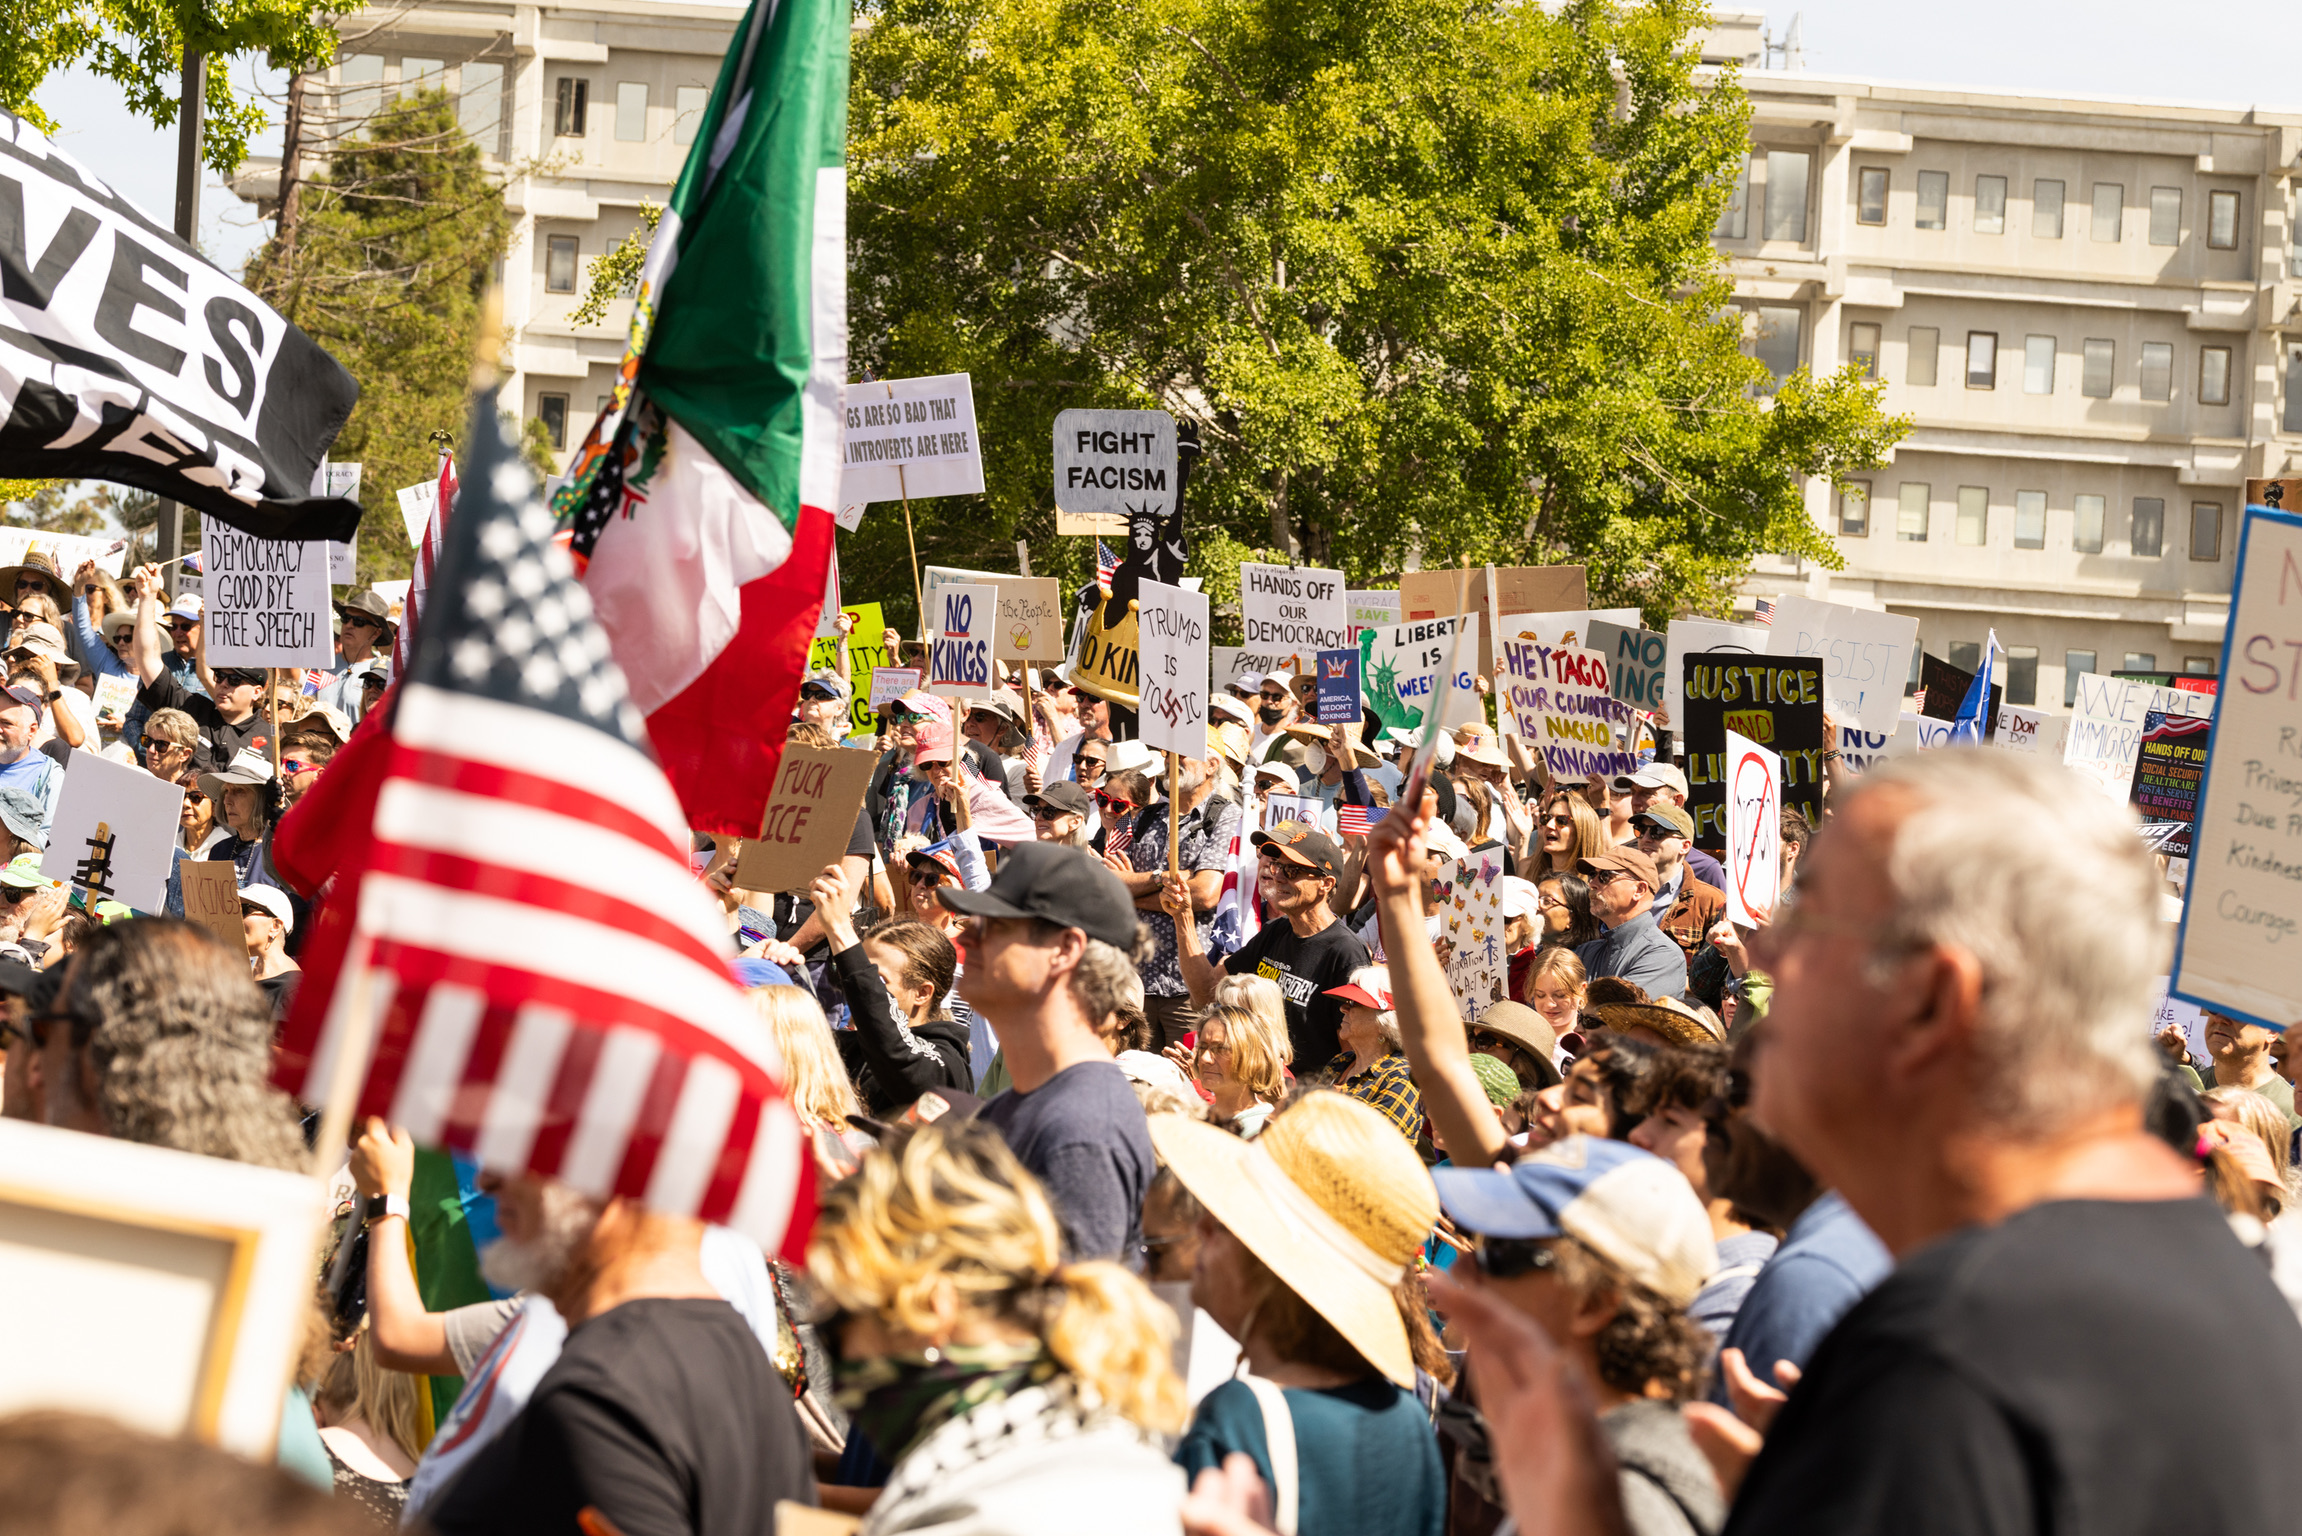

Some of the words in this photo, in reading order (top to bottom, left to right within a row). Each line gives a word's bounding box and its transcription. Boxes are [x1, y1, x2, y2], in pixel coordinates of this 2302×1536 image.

[865, 405, 885, 427] ARE
[887, 403, 901, 425] SO
[904, 401, 926, 424] BAD
[929, 398, 956, 421] THAT
[851, 436, 913, 464] INTROVERTS
[917, 435, 939, 457] ARE
[940, 432, 969, 455] HERE
[1077, 431, 1155, 454] FIGHT
[1068, 466, 1166, 491] FACISM
[210, 534, 305, 573] DEMOCRACY
[217, 574, 262, 609] GOOD
[267, 575, 295, 610] BYE
[1250, 572, 1301, 598] HANDS
[1307, 581, 1335, 600] OFF
[945, 594, 972, 632] NO
[1143, 608, 1201, 646] TRUMP
[1279, 604, 1307, 619] OUR
[1355, 608, 1390, 622] SAVE
[212, 611, 249, 648] FREE
[255, 611, 315, 648] SPEECH
[1248, 618, 1346, 649] DEMOCRACY!
[932, 638, 987, 683] KINGS
[1422, 648, 1442, 668] IS
[1504, 641, 1552, 681] HEY
[1617, 630, 1664, 668] NO
[875, 675, 899, 685] There
[1164, 654, 1177, 676] IS
[1612, 661, 1666, 708] ING
[1685, 664, 1818, 704] JUSTICE
[2082, 676, 2141, 723] WE
[2149, 688, 2202, 716] ARE
[1511, 684, 1553, 711] OUR
[1555, 690, 1635, 729] COUNTRY
[1517, 713, 1538, 740] IS
[1545, 716, 1610, 747] NACHO
[1726, 714, 1772, 742] AND
[2008, 731, 2028, 745] DO
[1543, 739, 1638, 777] KINGDOM!
[2144, 741, 2173, 757] HANDS
[2174, 745, 2191, 760] OFF
[779, 759, 833, 799] FUCK
[1688, 748, 1823, 787] LITY
[2141, 762, 2167, 777] SOCIAL
[2168, 766, 2204, 781] SECURITY
[2142, 774, 2198, 791] HEALTHCARE
[2137, 783, 2166, 797] POSTAL
[2166, 787, 2197, 801] SERVICE
[2139, 793, 2150, 804] VA
[2152, 795, 2193, 810] BENEFITS
[761, 803, 812, 844] ICE
[1271, 804, 1296, 827] NO
[2170, 808, 2196, 822] PARKS
[2234, 803, 2277, 831] Due
[2226, 838, 2302, 882] Kindnes
[196, 876, 240, 915] KINGS
[2154, 1008, 2175, 1021] ARE
